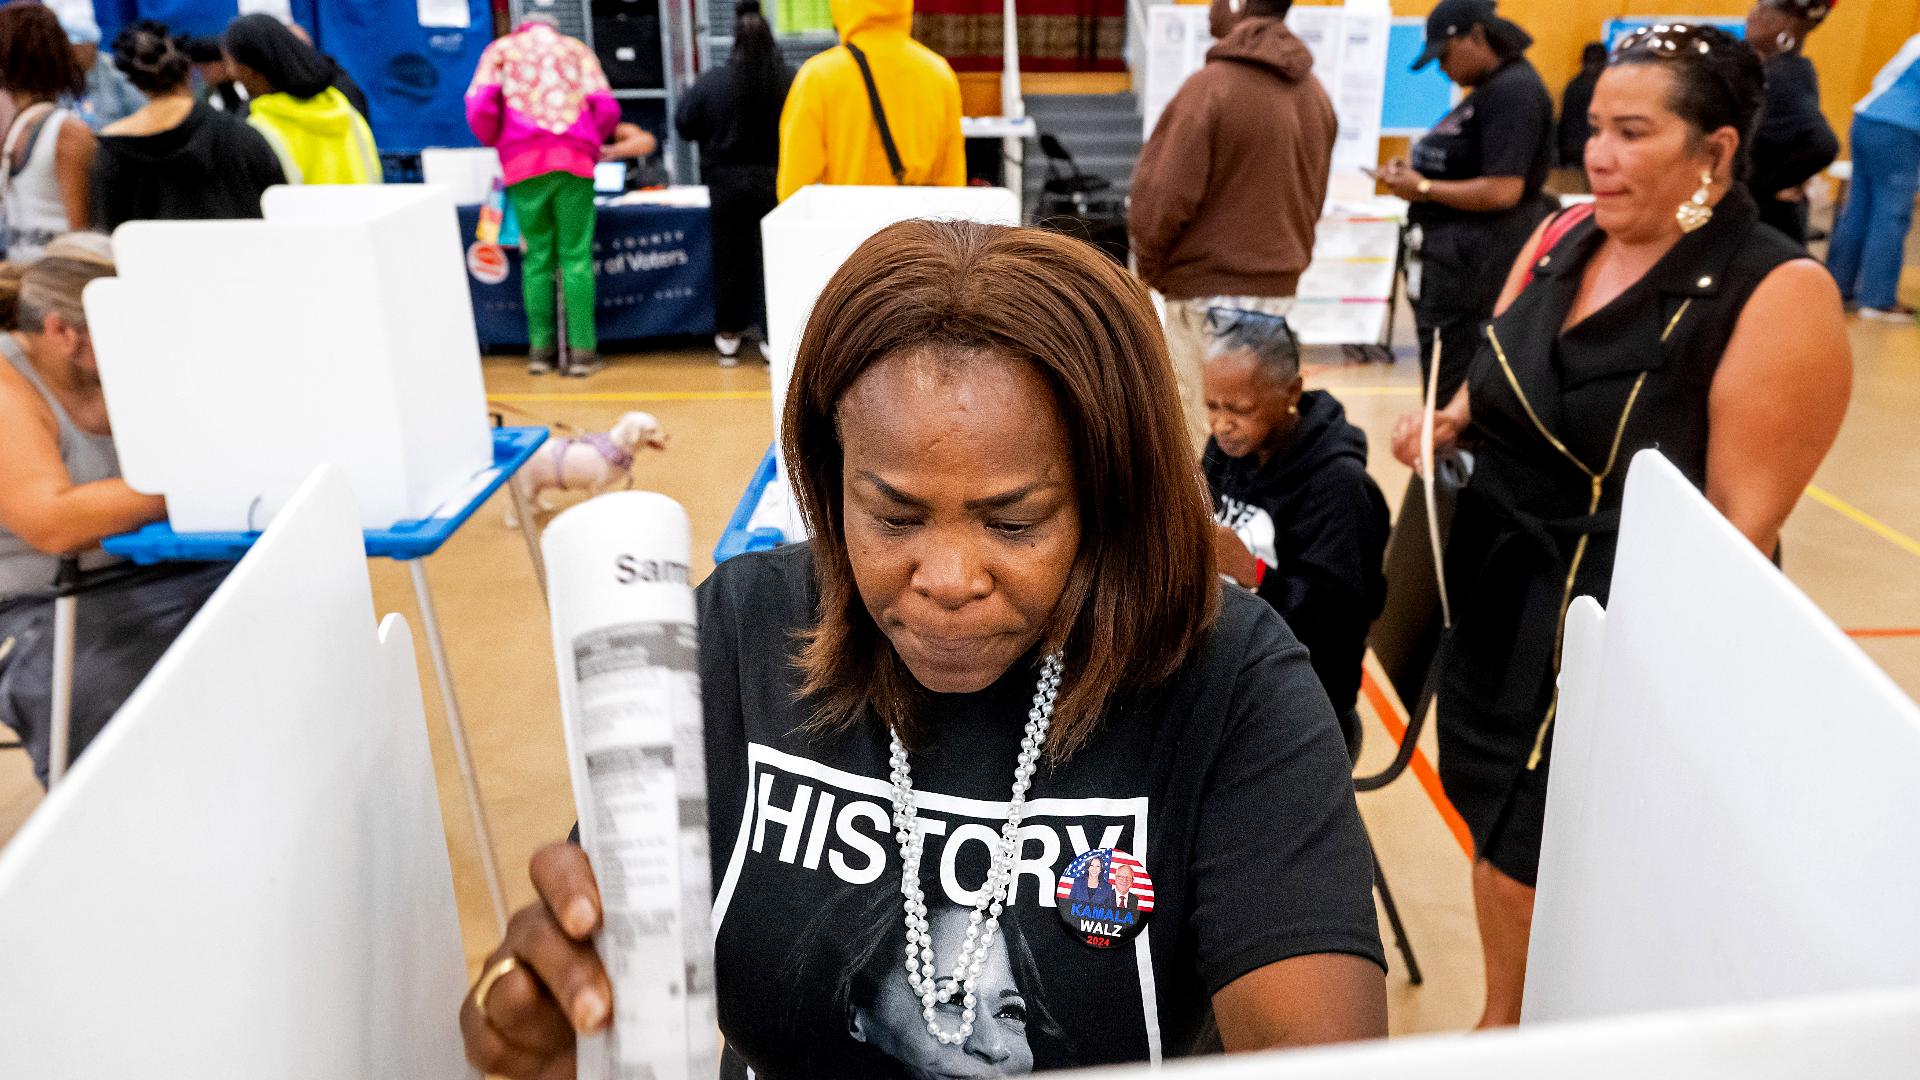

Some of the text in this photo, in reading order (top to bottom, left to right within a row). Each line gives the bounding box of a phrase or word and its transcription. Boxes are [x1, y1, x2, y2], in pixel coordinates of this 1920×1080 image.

[604, 252, 625, 275] of
[626, 248, 690, 271] Voters
[1071, 903, 1134, 925] KAMALA
[1080, 919, 1123, 937] WALZ
[1086, 935, 1111, 947] 2024
